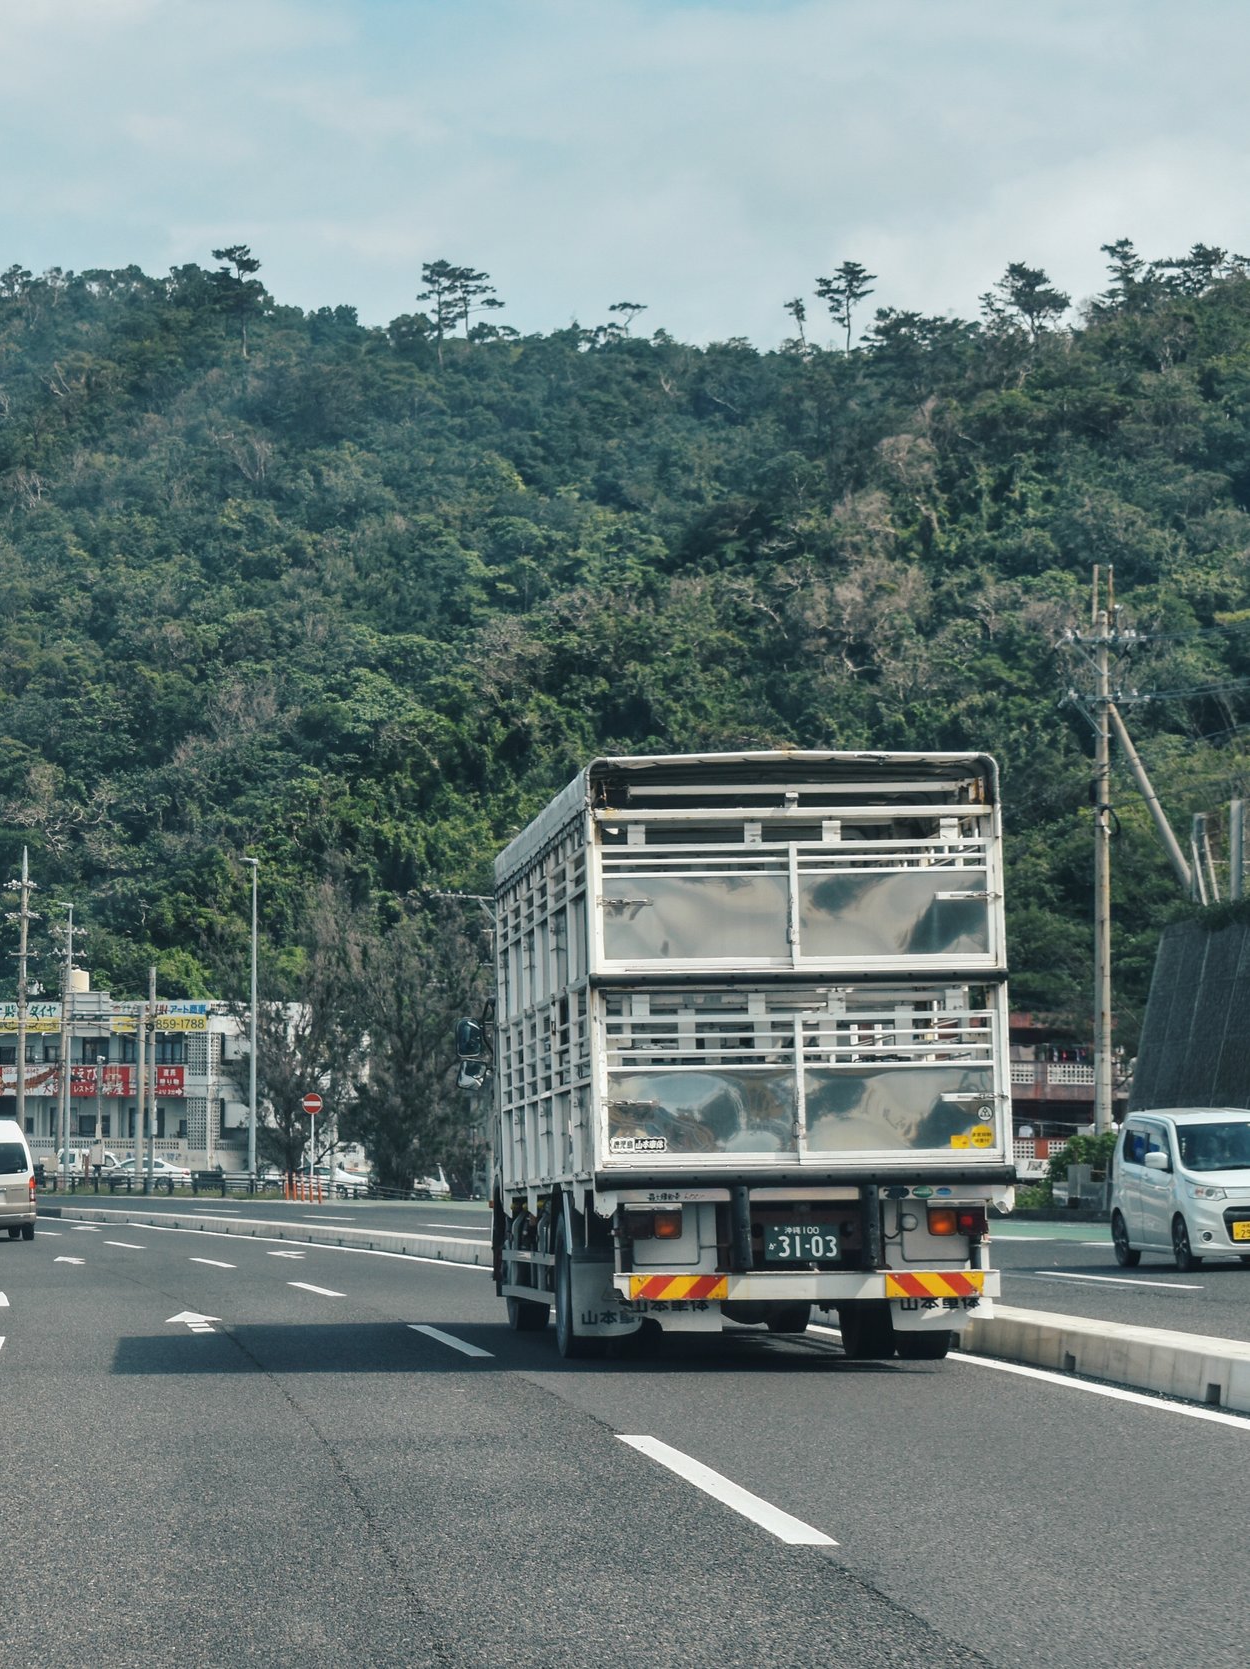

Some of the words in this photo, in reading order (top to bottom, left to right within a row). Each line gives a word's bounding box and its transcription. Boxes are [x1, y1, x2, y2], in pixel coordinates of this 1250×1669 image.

[29, 1004, 57, 1017] ダイヤ
[155, 1018, 205, 1030] 859-1788
[72, 1083, 100, 1093] レストラ
[778, 1235, 837, 1257] 31-03
[581, 1309, 643, 1325] 山本車
